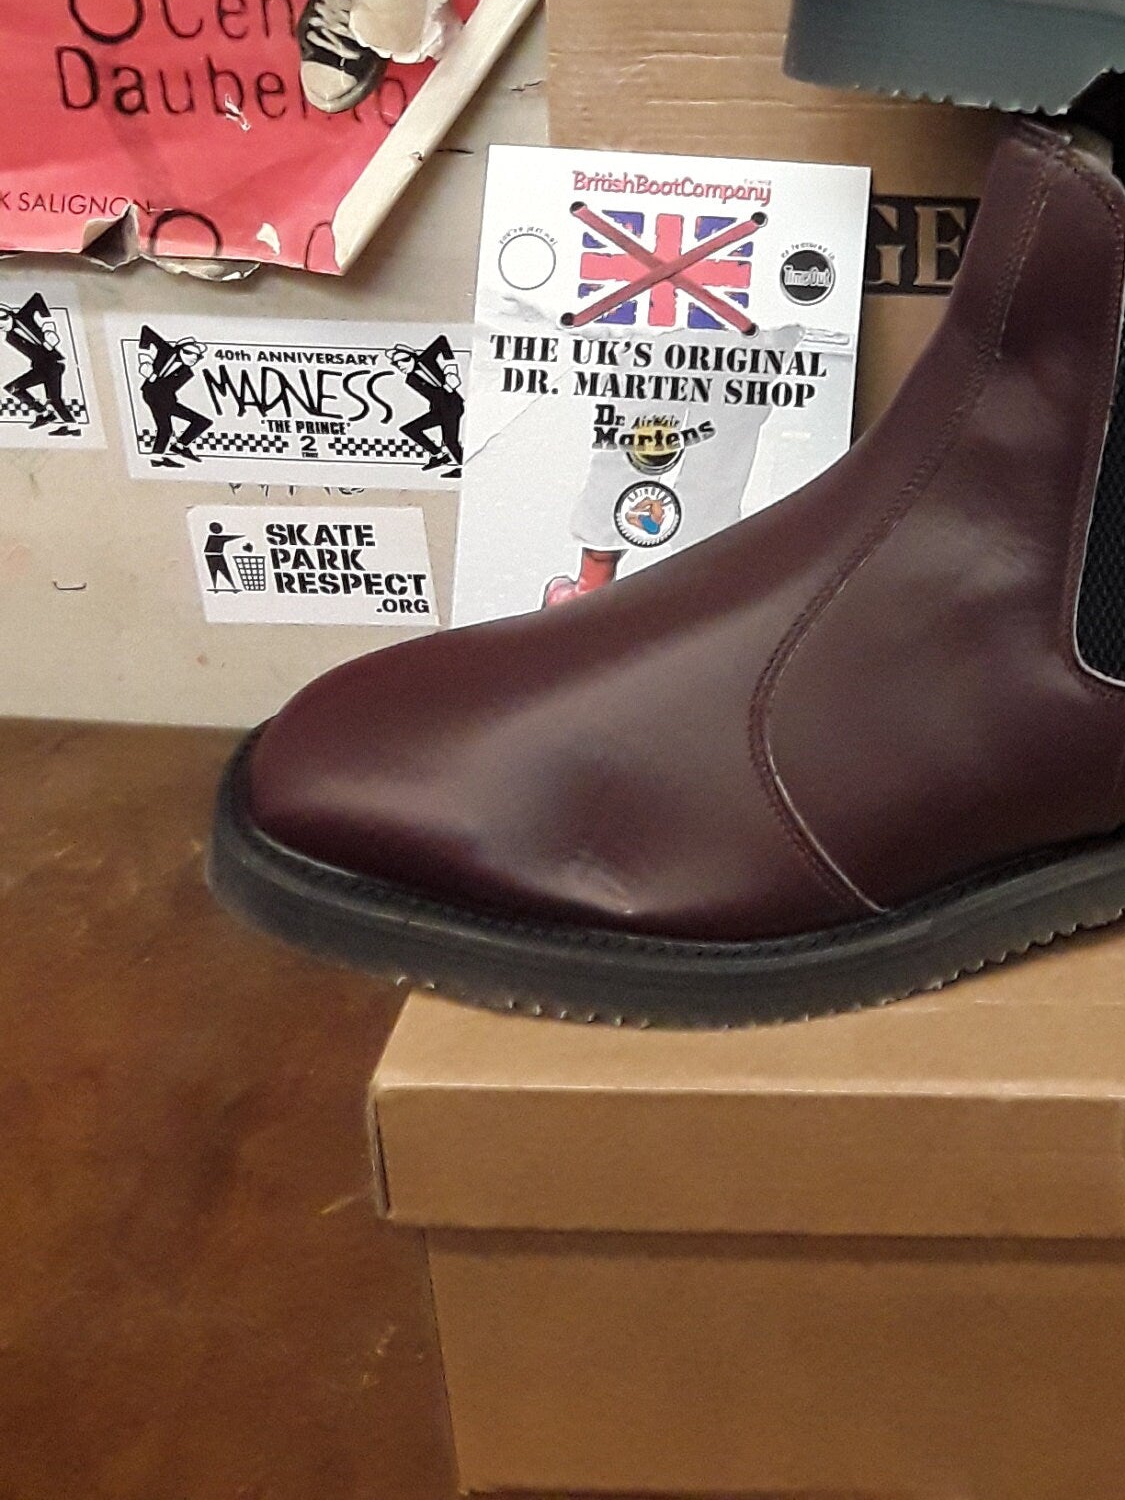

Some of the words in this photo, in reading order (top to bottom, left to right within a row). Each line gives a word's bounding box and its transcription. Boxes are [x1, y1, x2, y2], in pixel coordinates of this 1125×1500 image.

[214, 349, 251, 361] 40th
[257, 351, 379, 365] ANNIVERSARY
[490, 334, 559, 363] THE
[573, 339, 652, 368] UK'S
[665, 344, 828, 378] ORIGINAL
[202, 364, 395, 424] MADNESS
[501, 367, 559, 395] DR.
[573, 371, 713, 404] MARTEN
[724, 380, 816, 408] SHOP
[300, 435, 317, 451] 2
[592, 421, 716, 451] Martens
[265, 523, 375, 547] SKATE
[271, 548, 366, 571] PARK
[274, 572, 426, 595] RESPECT
[375, 599, 430, 614] .ORG
